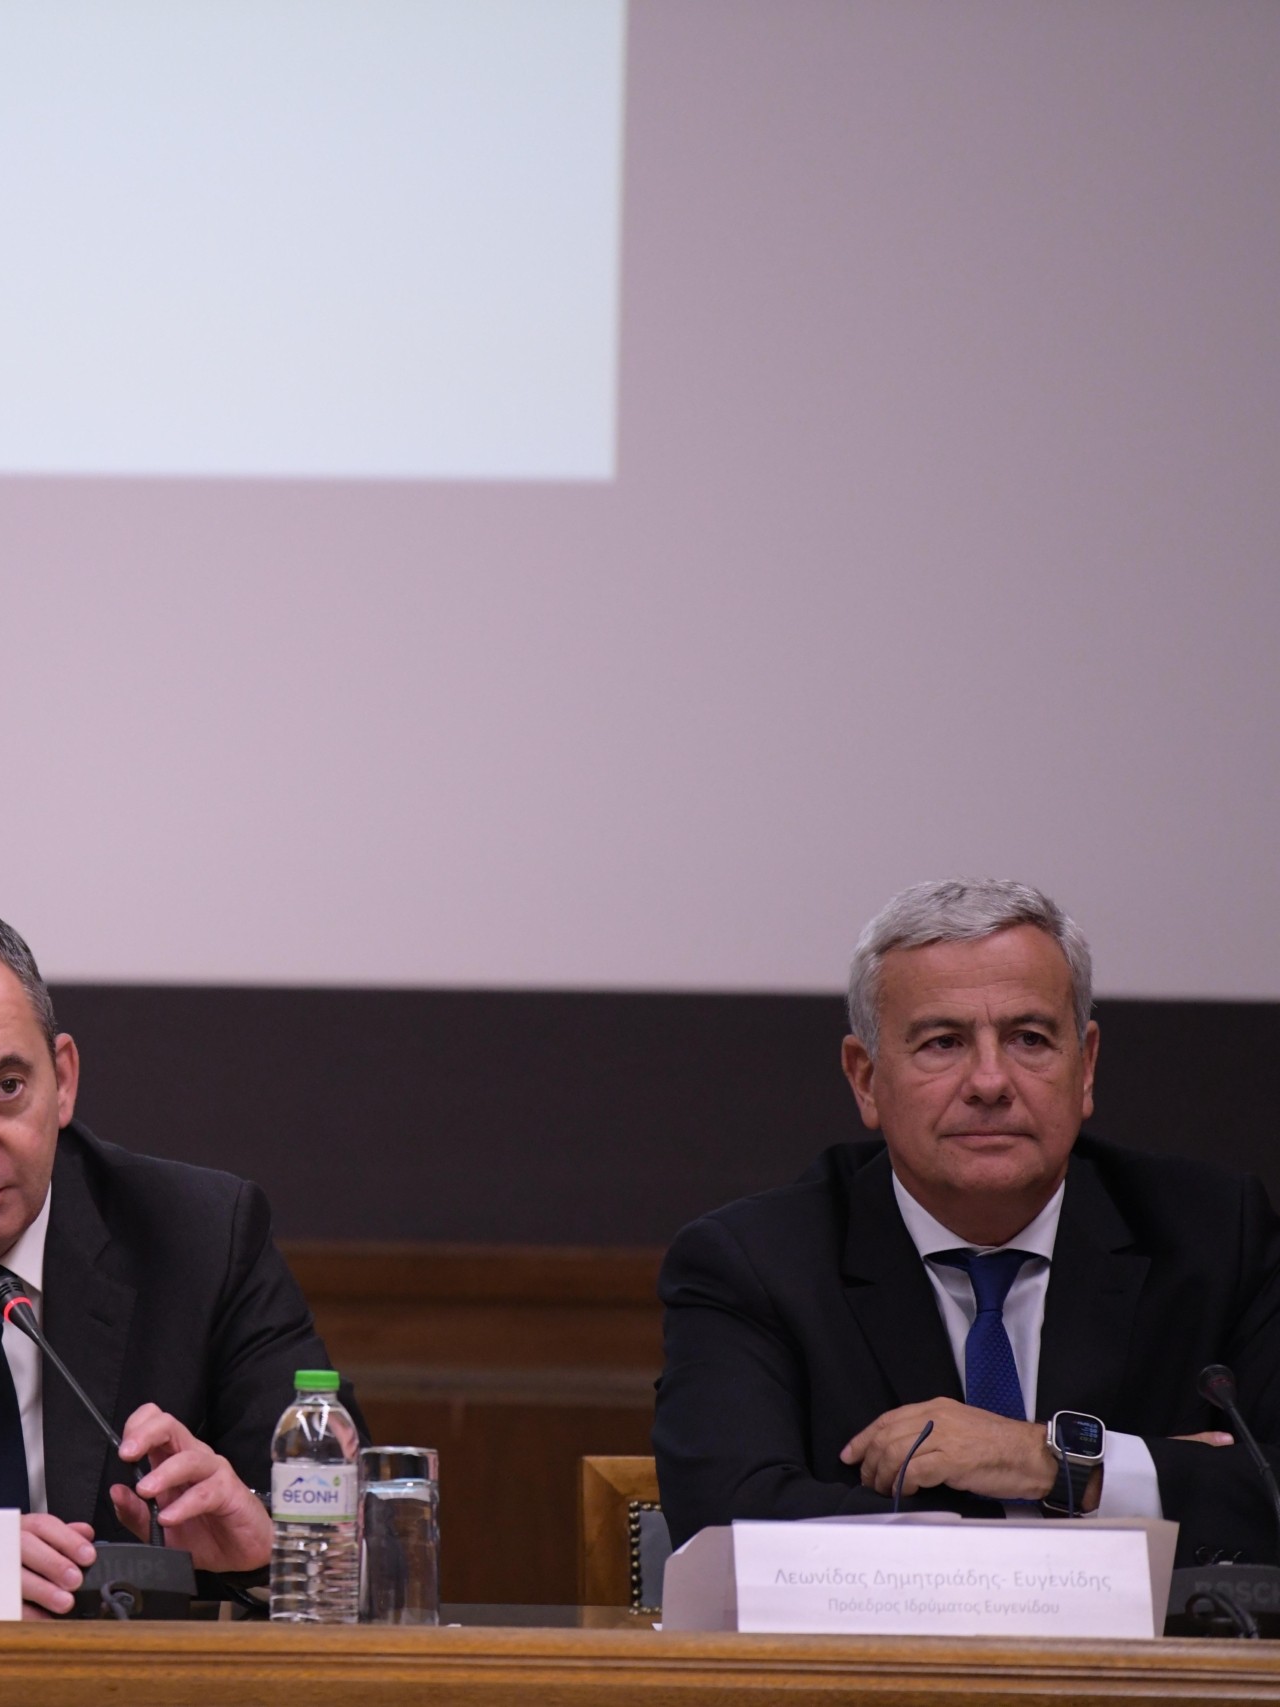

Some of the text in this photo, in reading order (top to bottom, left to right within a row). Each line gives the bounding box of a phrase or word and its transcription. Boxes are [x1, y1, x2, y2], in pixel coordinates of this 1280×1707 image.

[282, 1489, 339, 1504] ΘΕΟΝΗ
[774, 1568, 868, 1589] Λεωνίδας
[1013, 1570, 1112, 1593] Ευγενίδης
[828, 1598, 1060, 1616] Πρόεδρος Ιδρύματος Ευγενίδου
